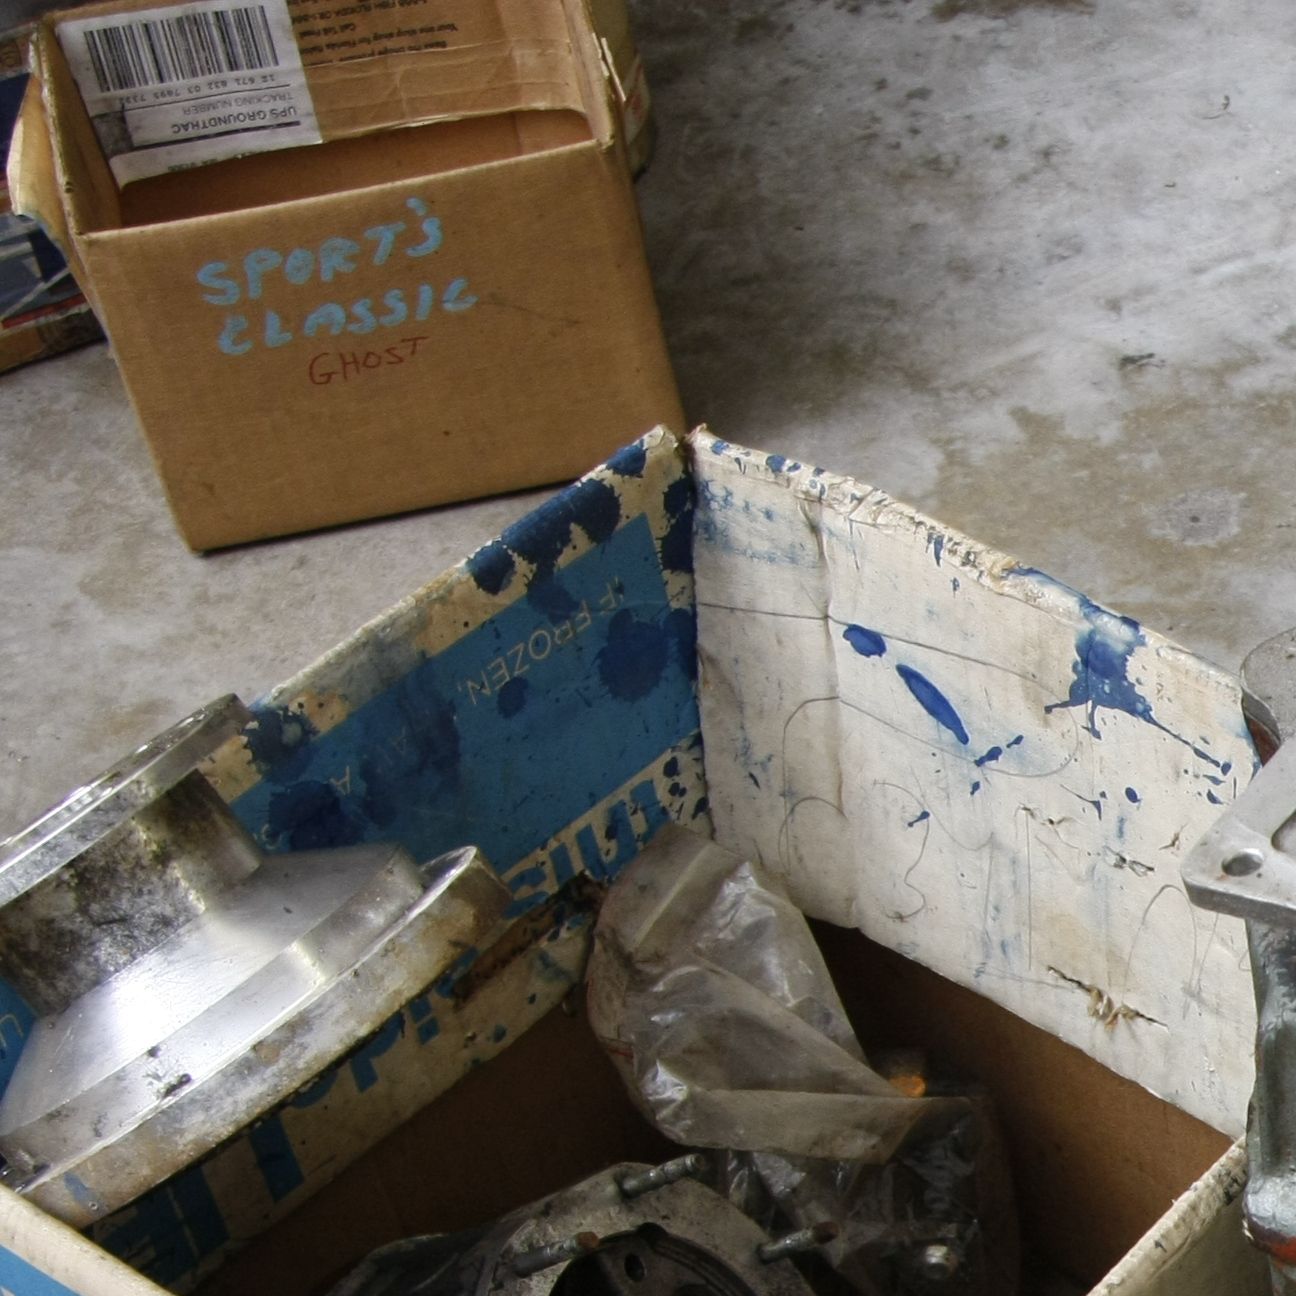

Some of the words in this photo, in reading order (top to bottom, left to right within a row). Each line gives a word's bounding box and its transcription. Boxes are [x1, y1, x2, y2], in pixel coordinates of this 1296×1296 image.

[182, 99, 233, 116] NUMBER
[236, 91, 293, 108] TRACKING
[267, 105, 297, 119] UPS
[217, 275, 479, 355] CLASSIC
[308, 335, 430, 386] GHOST
